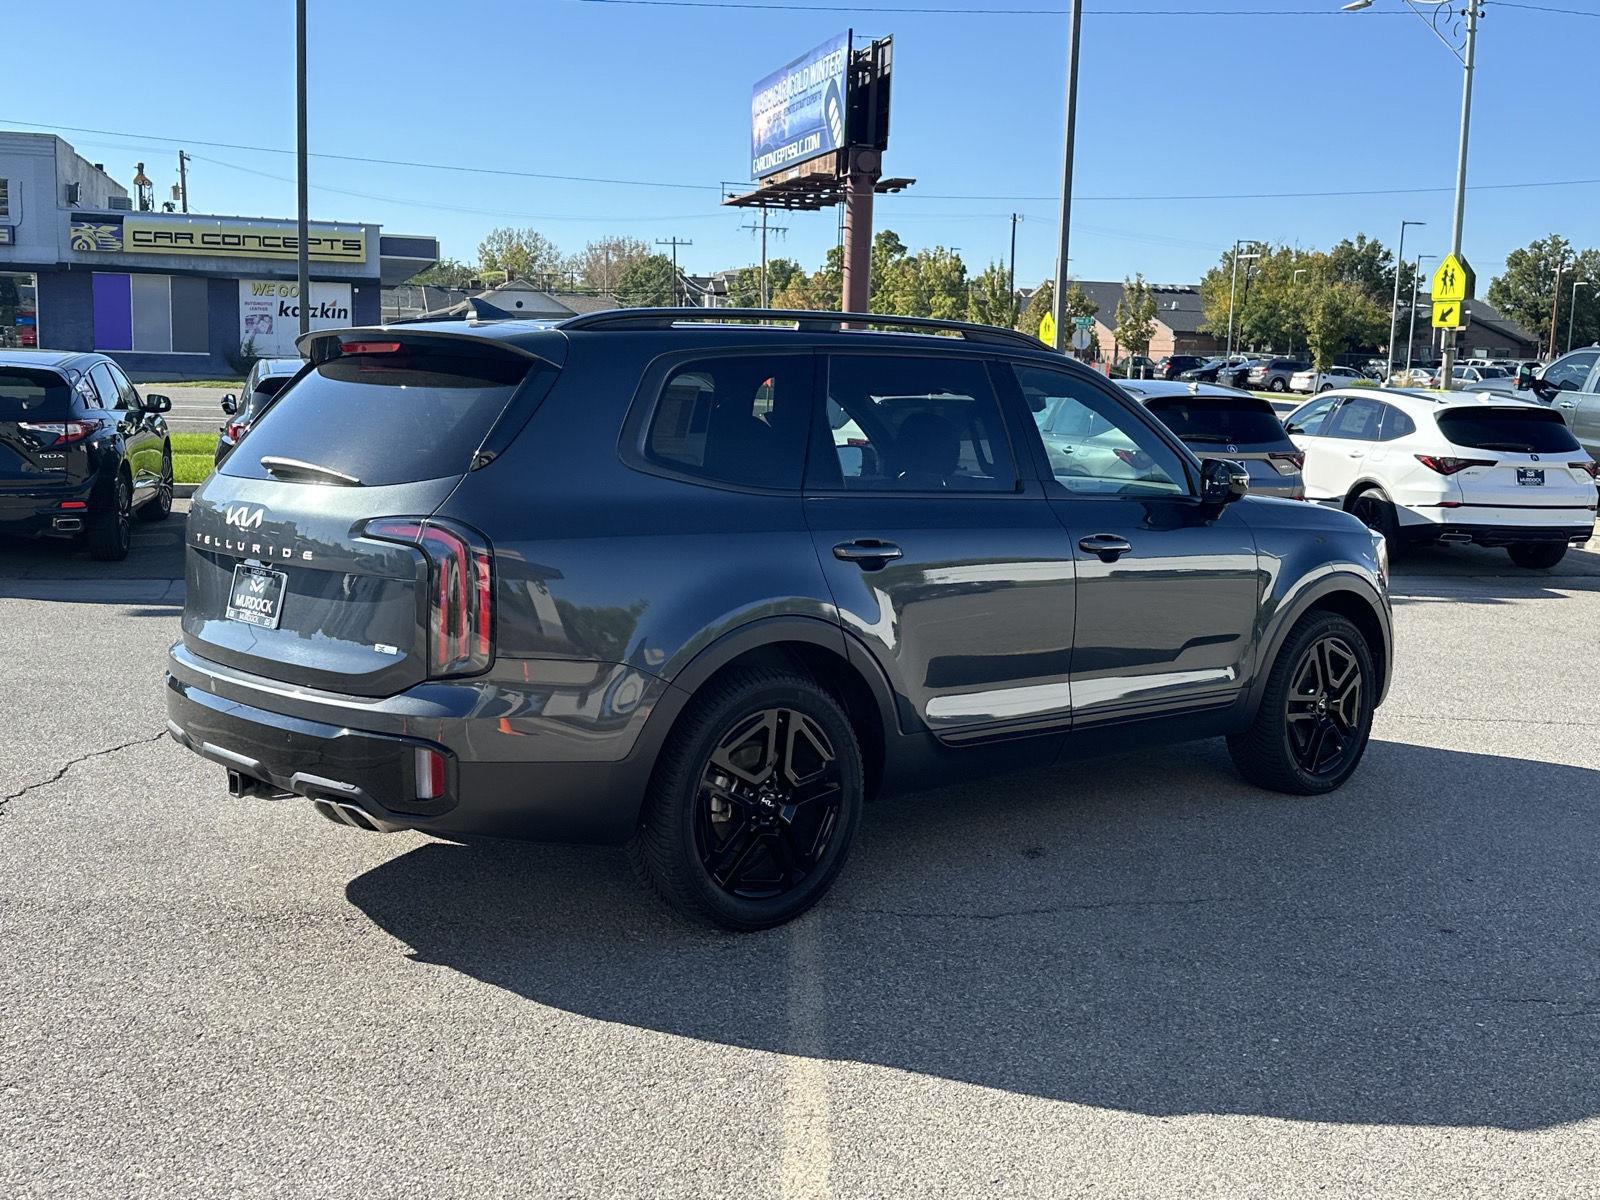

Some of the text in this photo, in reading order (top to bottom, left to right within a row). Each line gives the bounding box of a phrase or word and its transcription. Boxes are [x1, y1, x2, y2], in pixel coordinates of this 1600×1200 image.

[132, 230, 362, 251] CAR CONCEPTS
[251, 282, 276, 297] WE
[278, 300, 349, 319] kazkin
[196, 533, 313, 561] TELLURIDE
[235, 594, 274, 614] MURDOCK
